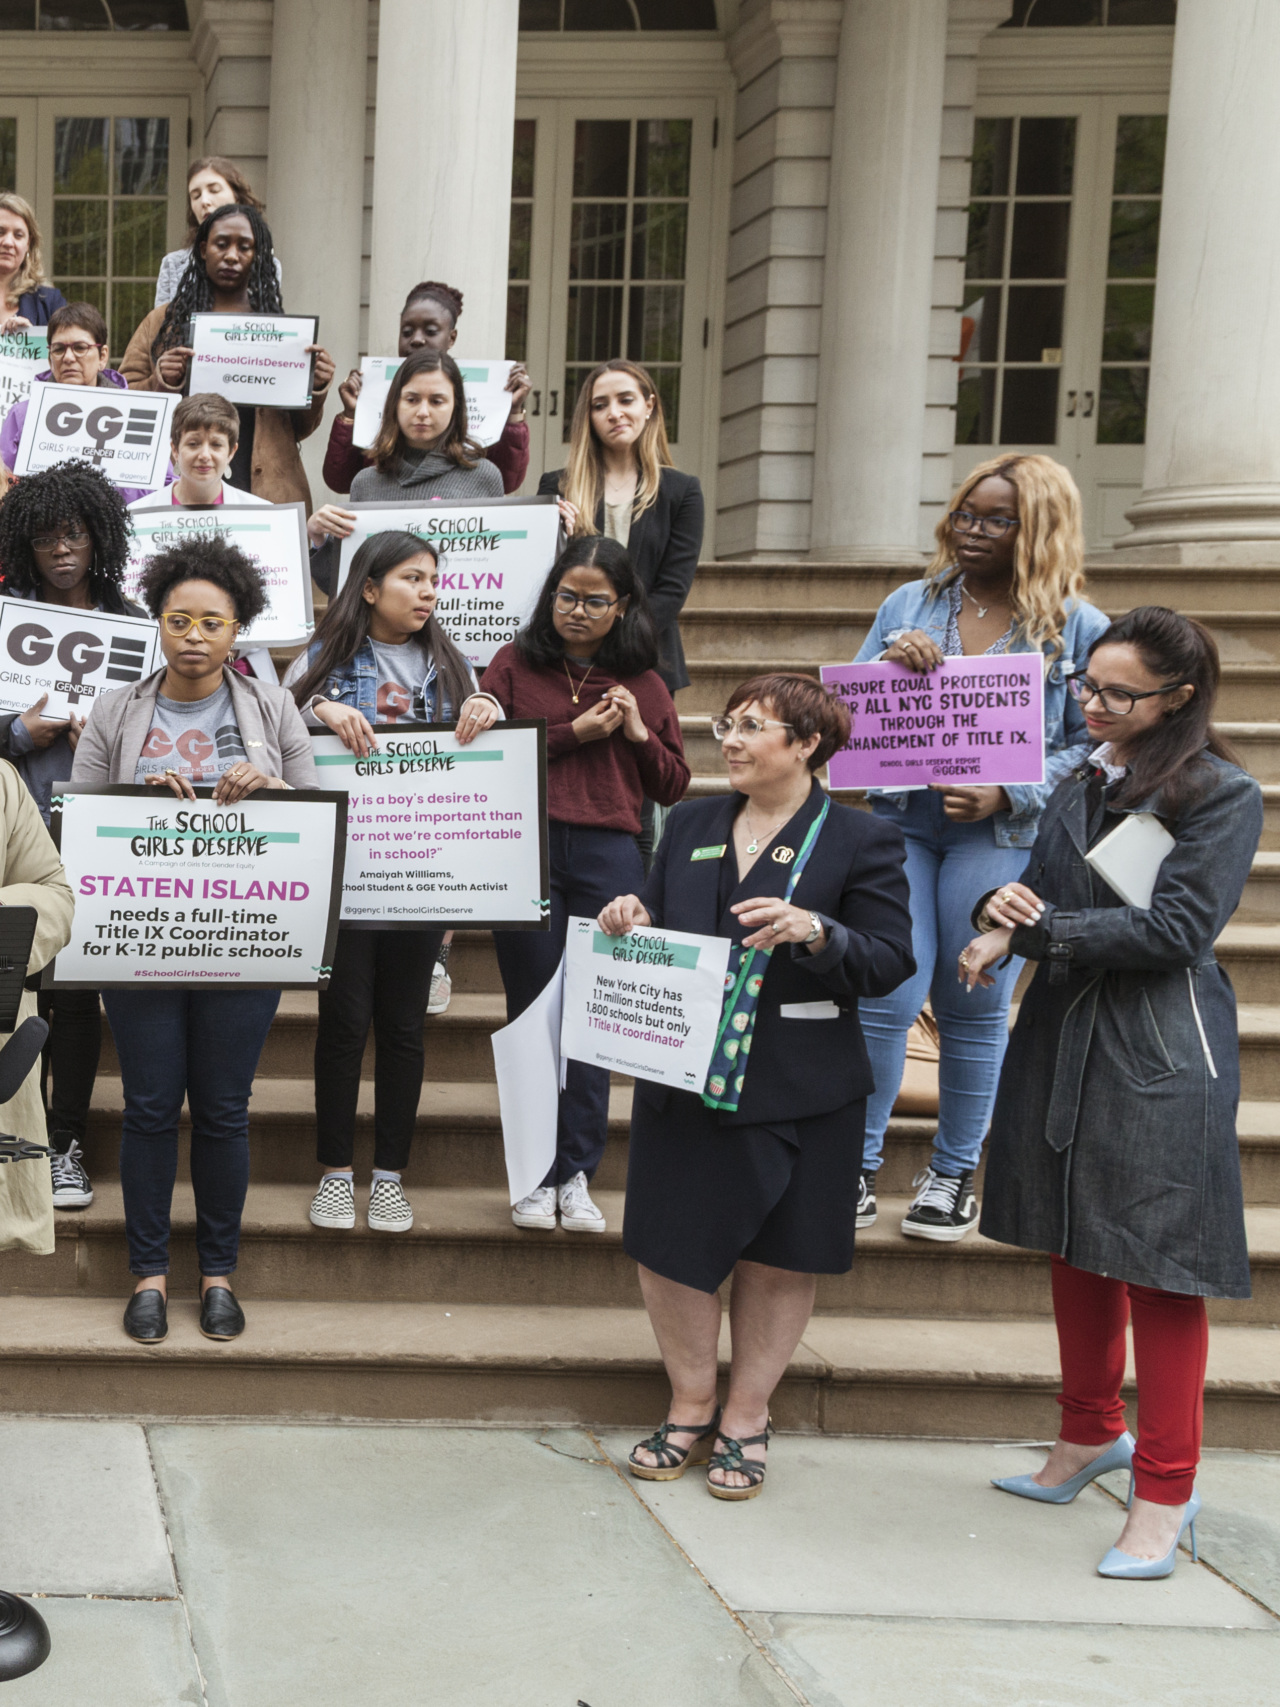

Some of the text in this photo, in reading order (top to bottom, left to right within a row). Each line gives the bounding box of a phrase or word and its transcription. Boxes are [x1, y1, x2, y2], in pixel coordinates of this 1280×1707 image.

[245, 322, 279, 332] SCHOOL
[225, 333, 284, 342] GIRLS DESERVE
[197, 355, 305, 369] #SchoolGirlsDeserve
[223, 374, 276, 385] @GGENYC
[38, 442, 152, 461] GIRLS GENDER EQUITY
[177, 516, 223, 529] SCHOOL
[428, 517, 490, 536] SCHOOL
[439, 533, 501, 553] DESERVE
[435, 598, 504, 610] full-time
[0, 671, 31, 686] GIRLS
[35, 678, 52, 688] FOR
[56, 682, 94, 695] GENDER
[891, 673, 1031, 693] EQUAL PROTECTION
[865, 698, 891, 714] ALL
[899, 694, 933, 711] NYC
[941, 691, 1030, 710] STUDENTS
[880, 714, 979, 731] THROUGH THE
[942, 731, 1032, 747] OF TITLE IX.
[386, 740, 444, 757] SCHOOL
[355, 756, 456, 776] GIRLS DESERVE
[880, 757, 981, 768] SCHOOL GIRLS DESERVE REPORT
[932, 765, 981, 776] @GGENYC
[362, 794, 373, 805] is
[376, 795, 385, 805] a
[388, 793, 424, 808] boy's
[427, 792, 470, 804] desire
[474, 792, 487, 803] to
[146, 811, 254, 833] THE SCHOOL
[357, 814, 372, 823] us
[376, 813, 412, 823] more
[415, 811, 486, 825] important
[490, 811, 522, 821] than
[352, 832, 365, 841] or
[368, 831, 390, 841] not
[434, 828, 522, 840] comfortable
[130, 835, 269, 858] GIRLS DESERVE
[369, 847, 442, 860] in school?"
[360, 870, 403, 881] Amaiyah
[79, 875, 310, 901] STATEN ISLAND
[367, 883, 404, 891] Student
[438, 883, 467, 891] Youth
[470, 883, 508, 891] Activist
[110, 908, 277, 924] needs a full-time
[344, 906, 473, 914] @ggenyc #SchoolGirlsDeserve
[95, 924, 289, 942] Title IX Coordinator
[631, 933, 669, 951] SCHOOL
[83, 942, 302, 960] for K-12 public schools
[613, 947, 674, 967] GIRLS DESERVE
[134, 969, 241, 978] #SchoolGirlsDeserve
[597, 975, 682, 1002] New York City has
[593, 989, 685, 1019] 1.1 million students,
[586, 1002, 691, 1036] 1,800 schools but only
[594, 1018, 685, 1049] Title IX coordinator
[616, 1059, 664, 1076] #SchoolGirlsDeserve
